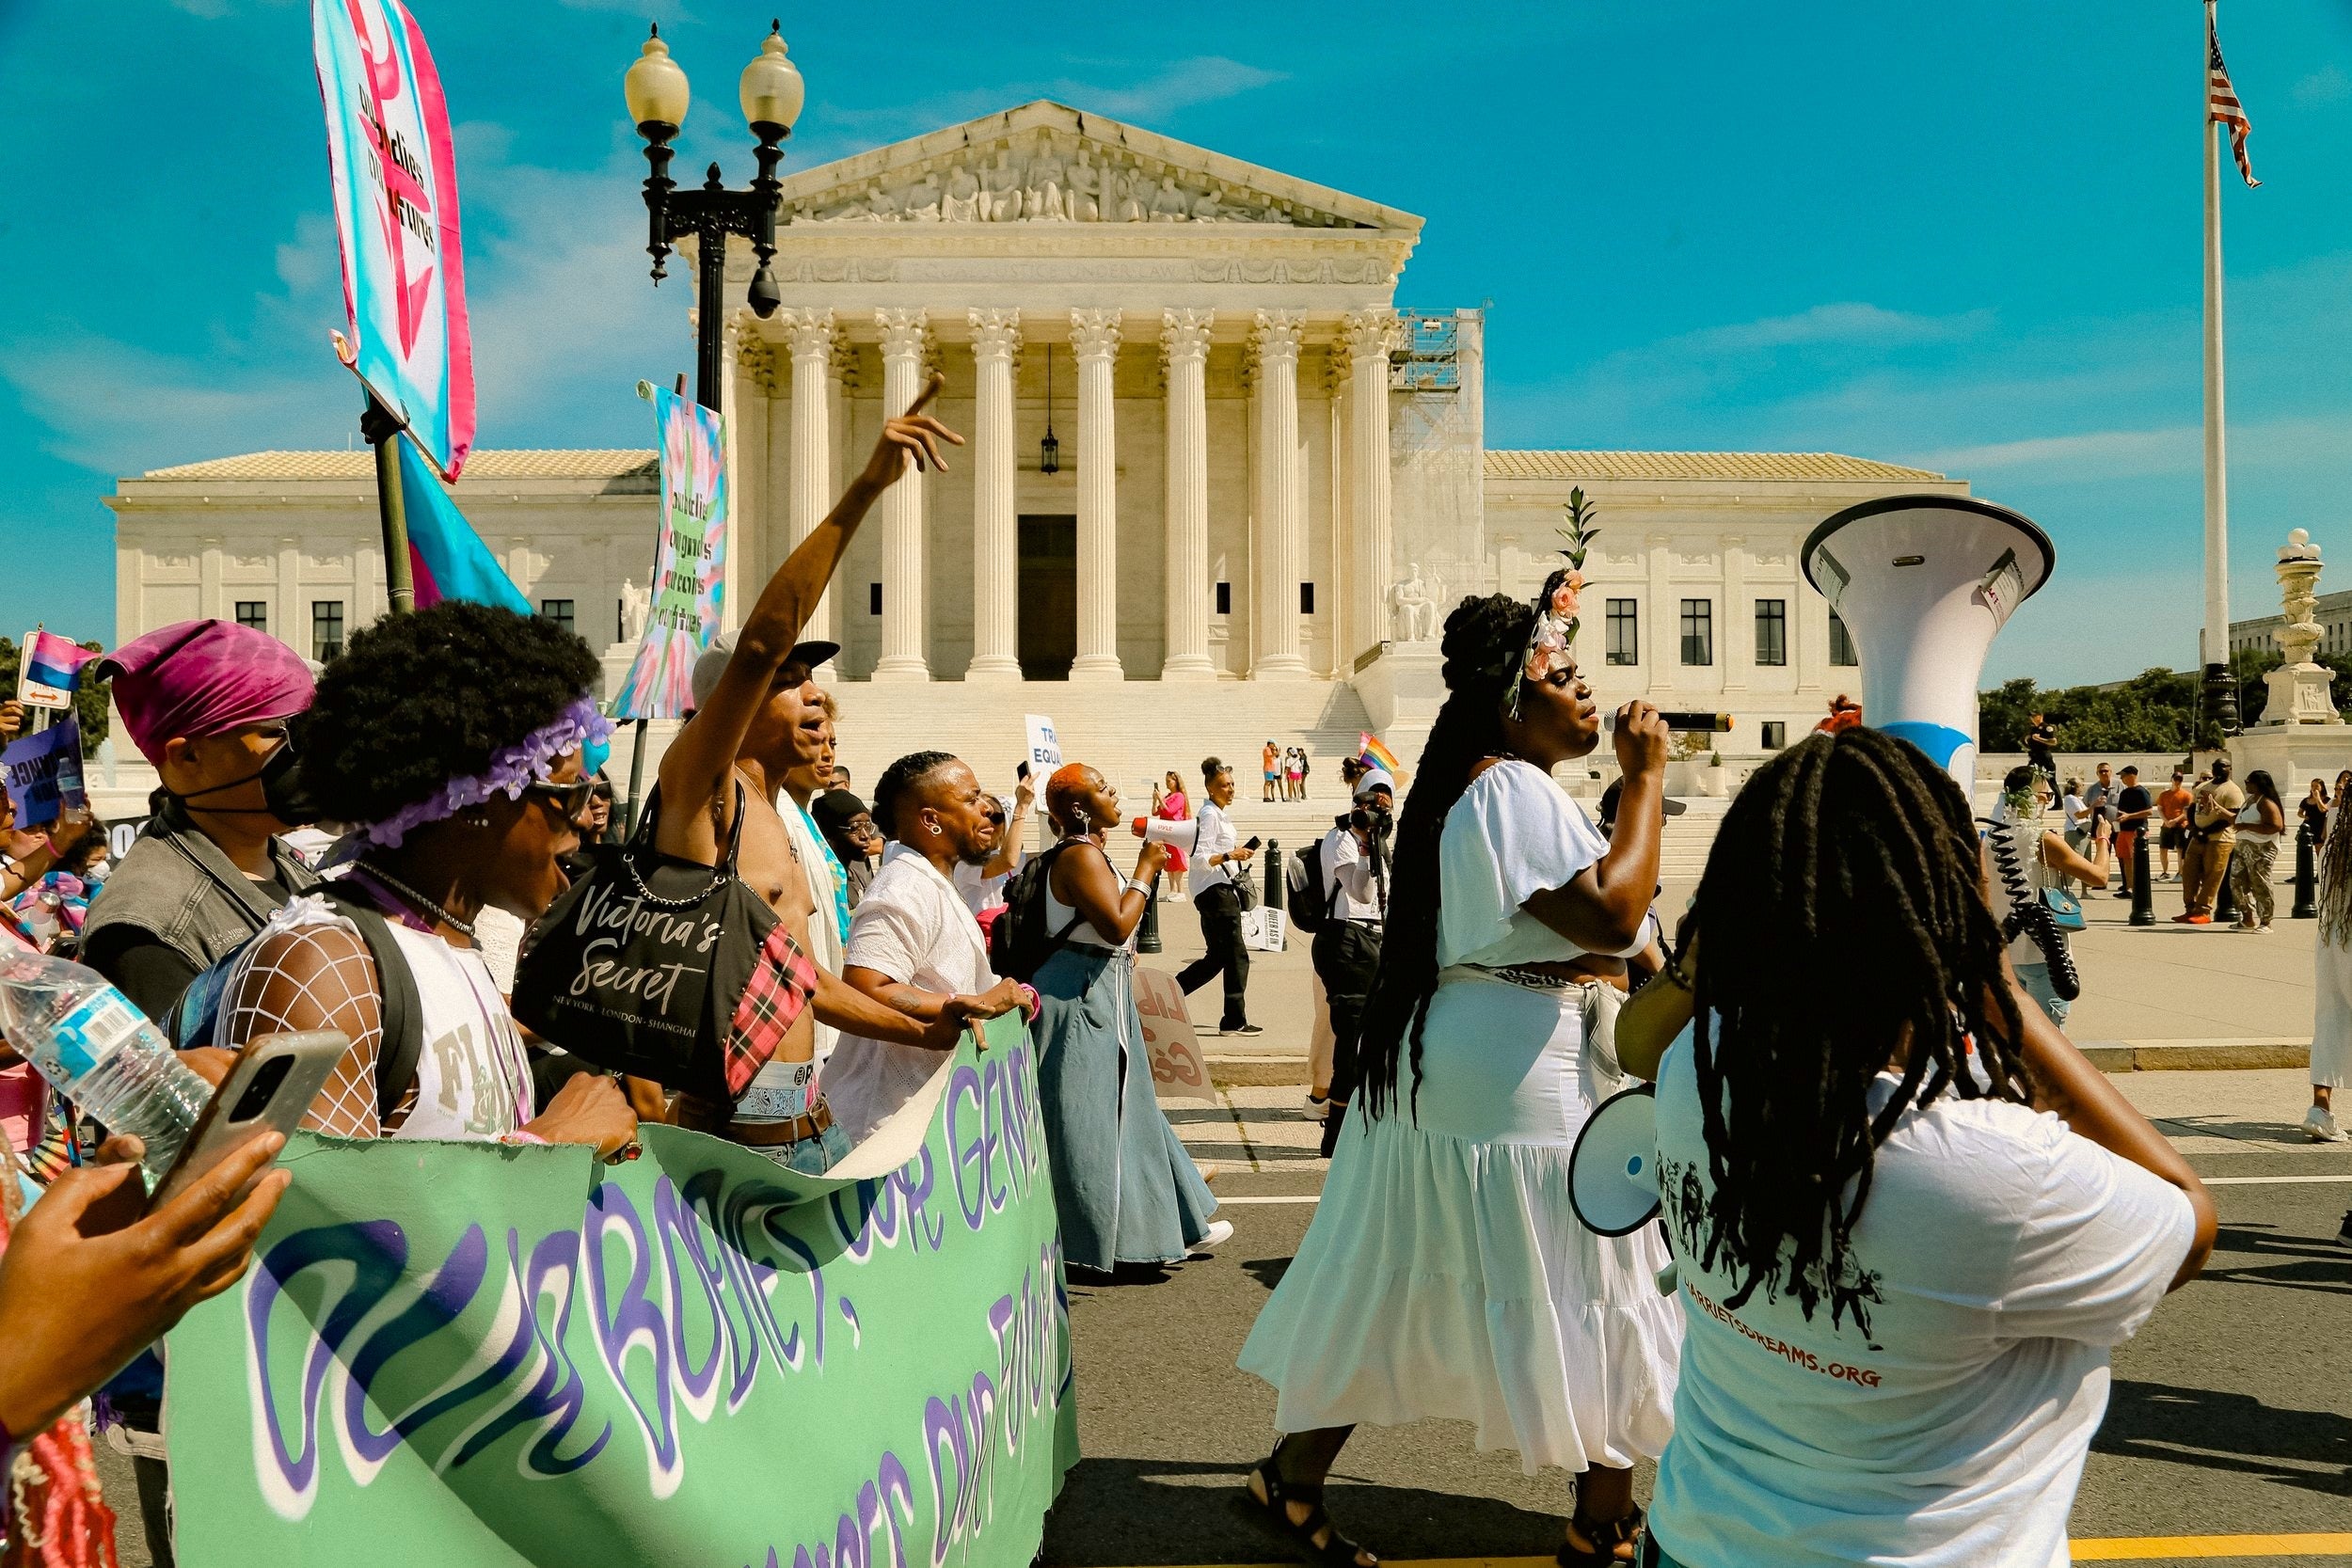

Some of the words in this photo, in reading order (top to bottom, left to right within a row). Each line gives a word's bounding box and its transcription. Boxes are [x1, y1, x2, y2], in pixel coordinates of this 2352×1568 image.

[576, 881, 724, 953] Victoria's
[570, 937, 706, 1015] Secret
[573, 1000, 596, 1013] YORK
[601, 1007, 643, 1024] LONDON
[647, 1019, 696, 1038] SHANGHAI
